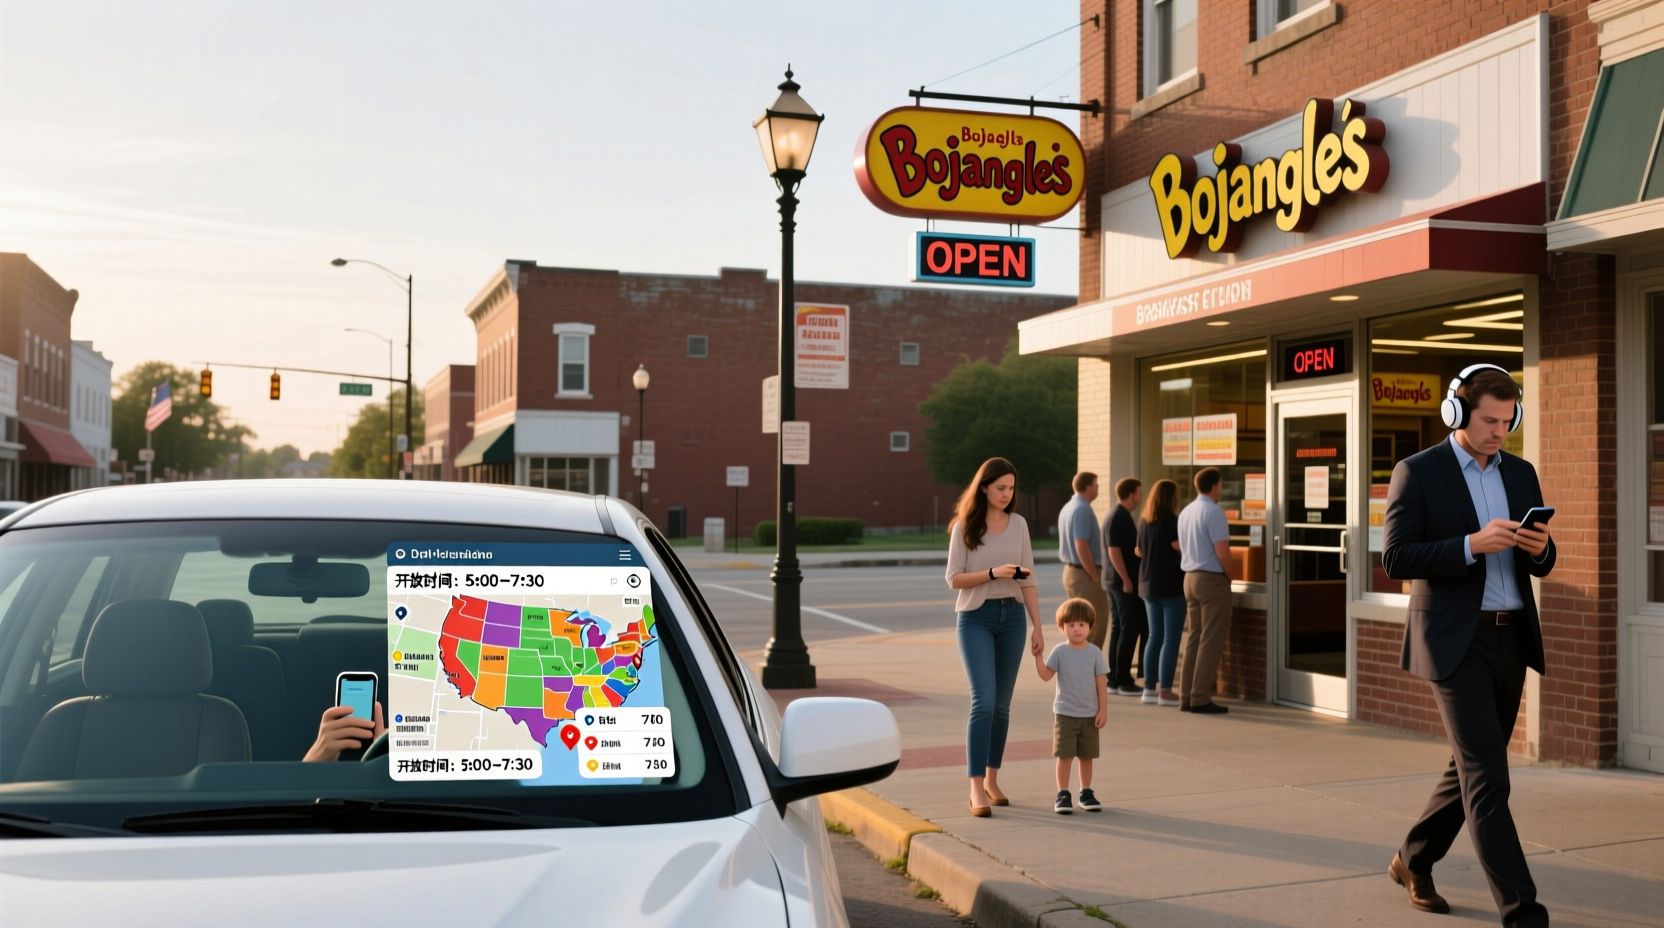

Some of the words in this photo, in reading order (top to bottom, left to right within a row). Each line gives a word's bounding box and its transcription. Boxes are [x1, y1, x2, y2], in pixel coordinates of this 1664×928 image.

[1149, 98, 1371, 260] Bojangle's
[926, 240, 1026, 278] OPEN
[1293, 346, 1335, 374] OPEN
